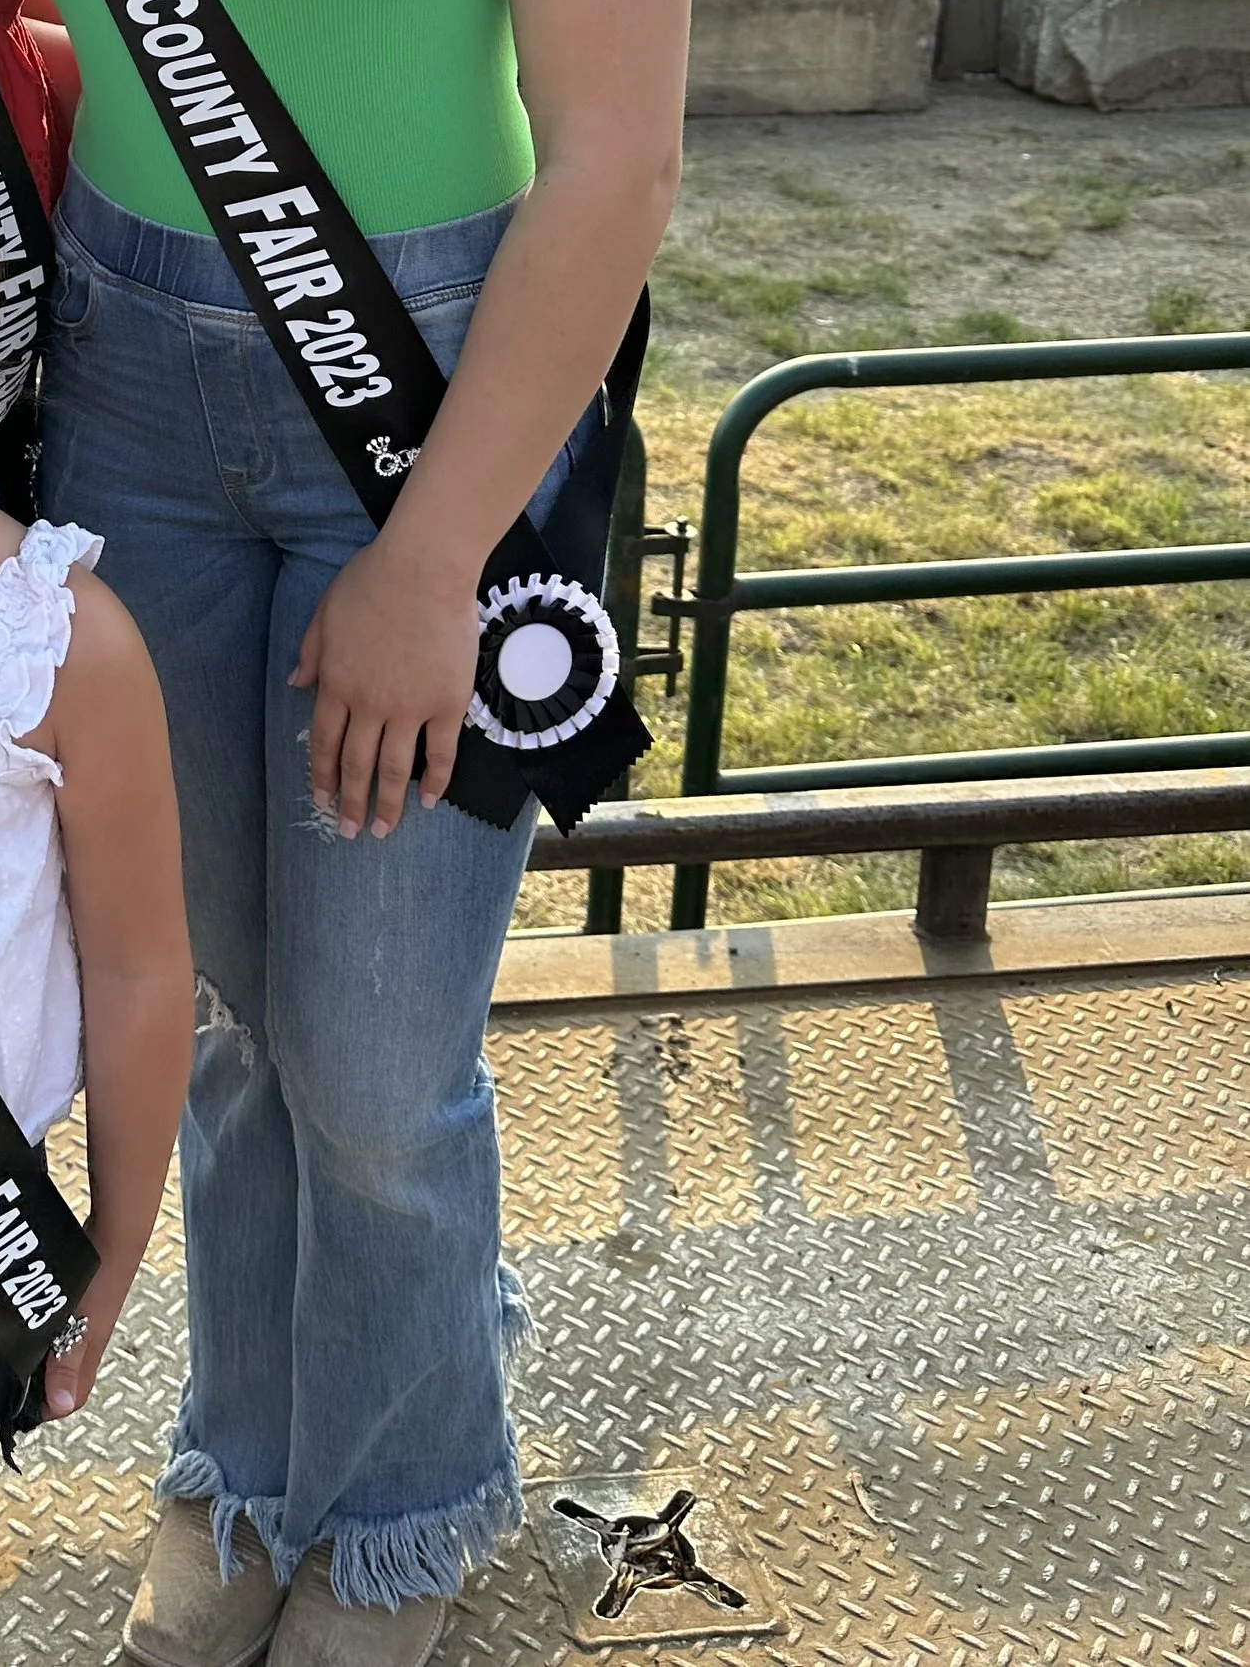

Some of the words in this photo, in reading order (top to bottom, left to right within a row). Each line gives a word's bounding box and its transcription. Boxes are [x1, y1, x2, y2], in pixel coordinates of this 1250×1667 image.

[225, 186, 343, 310] FAIR
[286, 310, 392, 407] 2023
[2, 1261, 67, 1328] 2023
